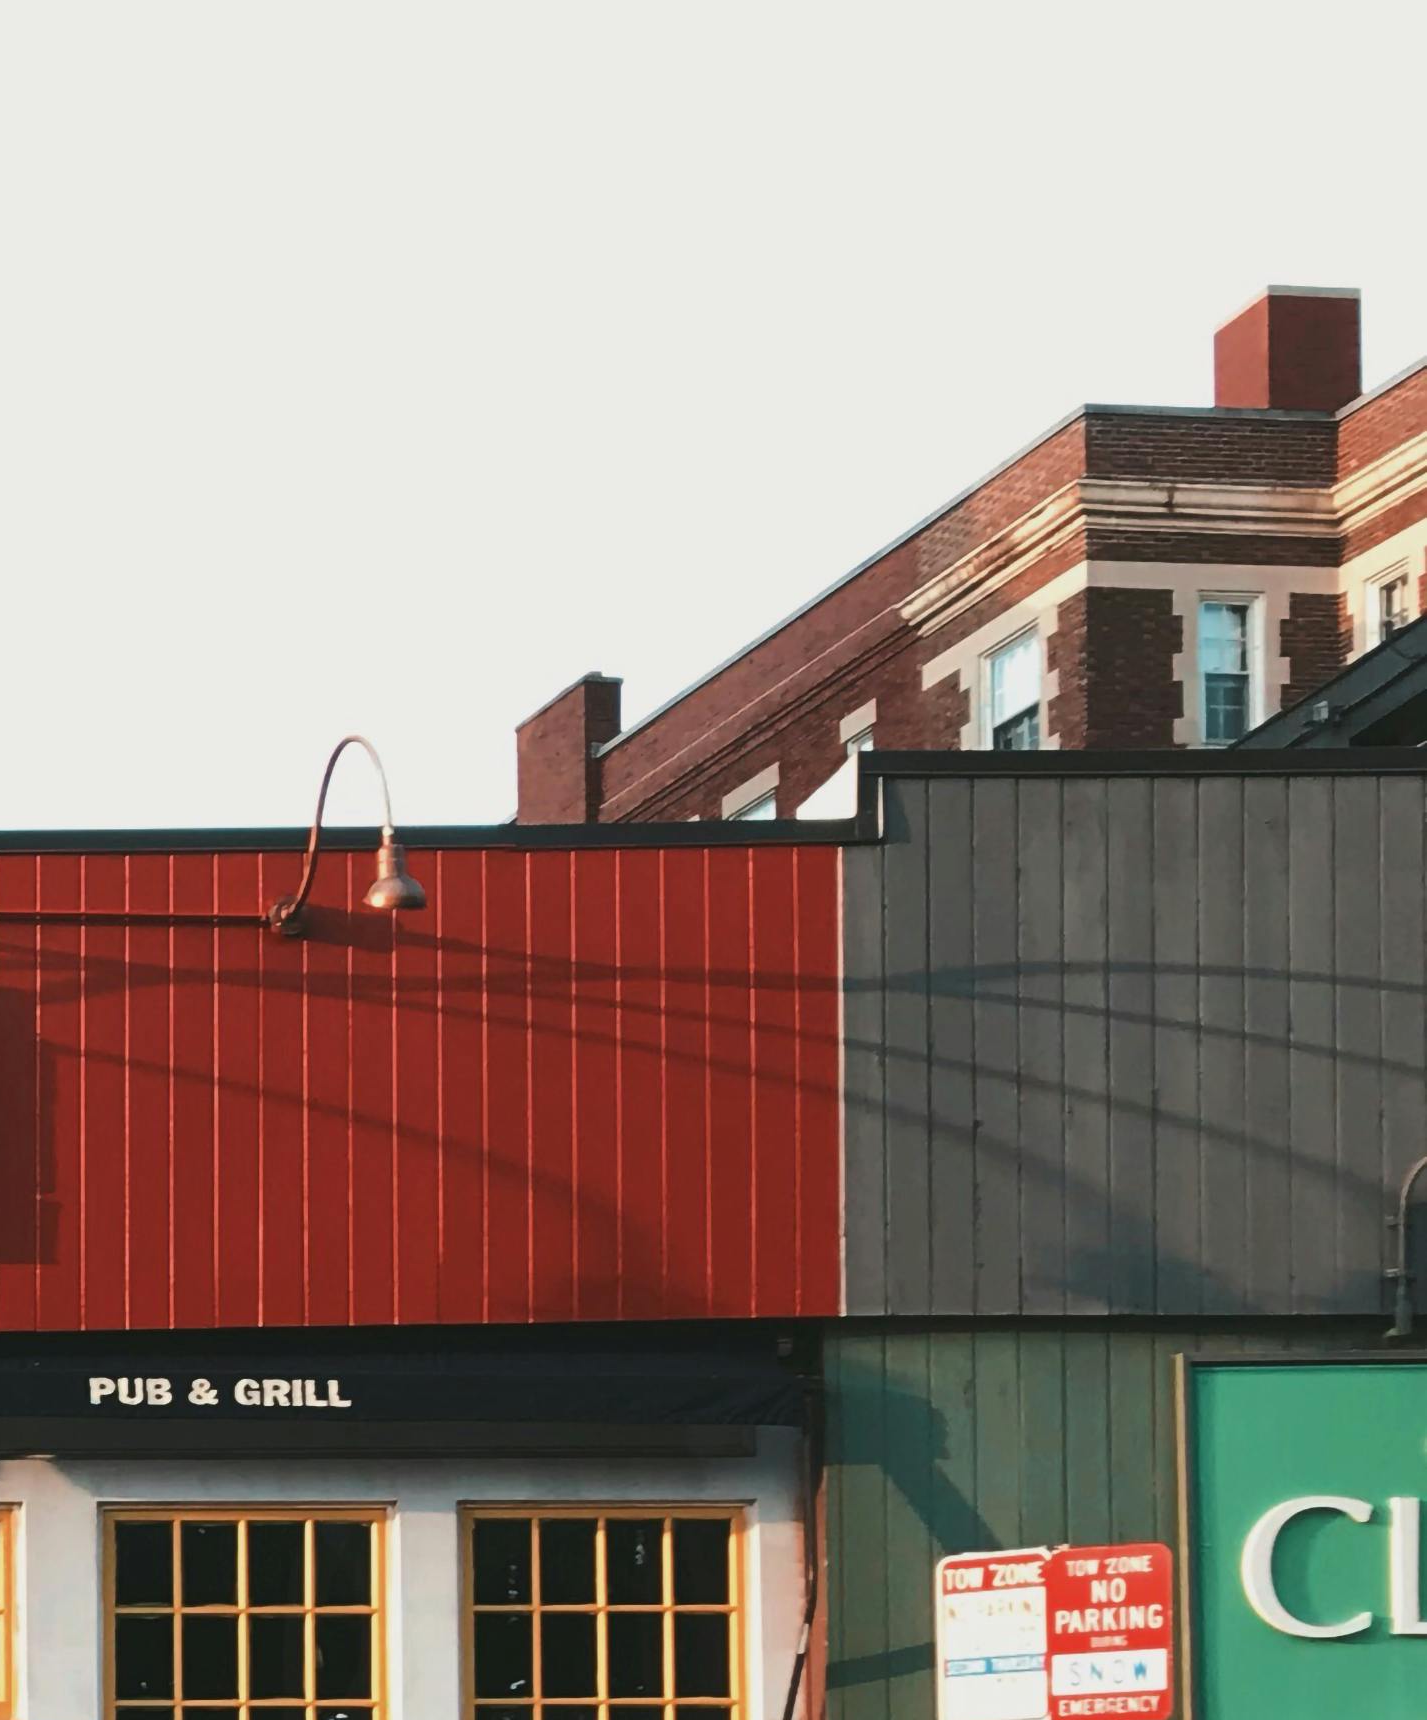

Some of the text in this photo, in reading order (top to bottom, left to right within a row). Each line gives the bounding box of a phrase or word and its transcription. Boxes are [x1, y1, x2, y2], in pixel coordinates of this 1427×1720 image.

[88, 1377, 352, 1408] PUB & GRILL
[943, 1561, 1046, 1590] TOW ZONE
[1065, 1555, 1154, 1577] TOW ZONE
[1091, 1577, 1127, 1604] NO
[1055, 1603, 1164, 1635] PARKING
[1069, 1658, 1148, 1687] SNOW
[1058, 1695, 1160, 1717] EMERGENCY
